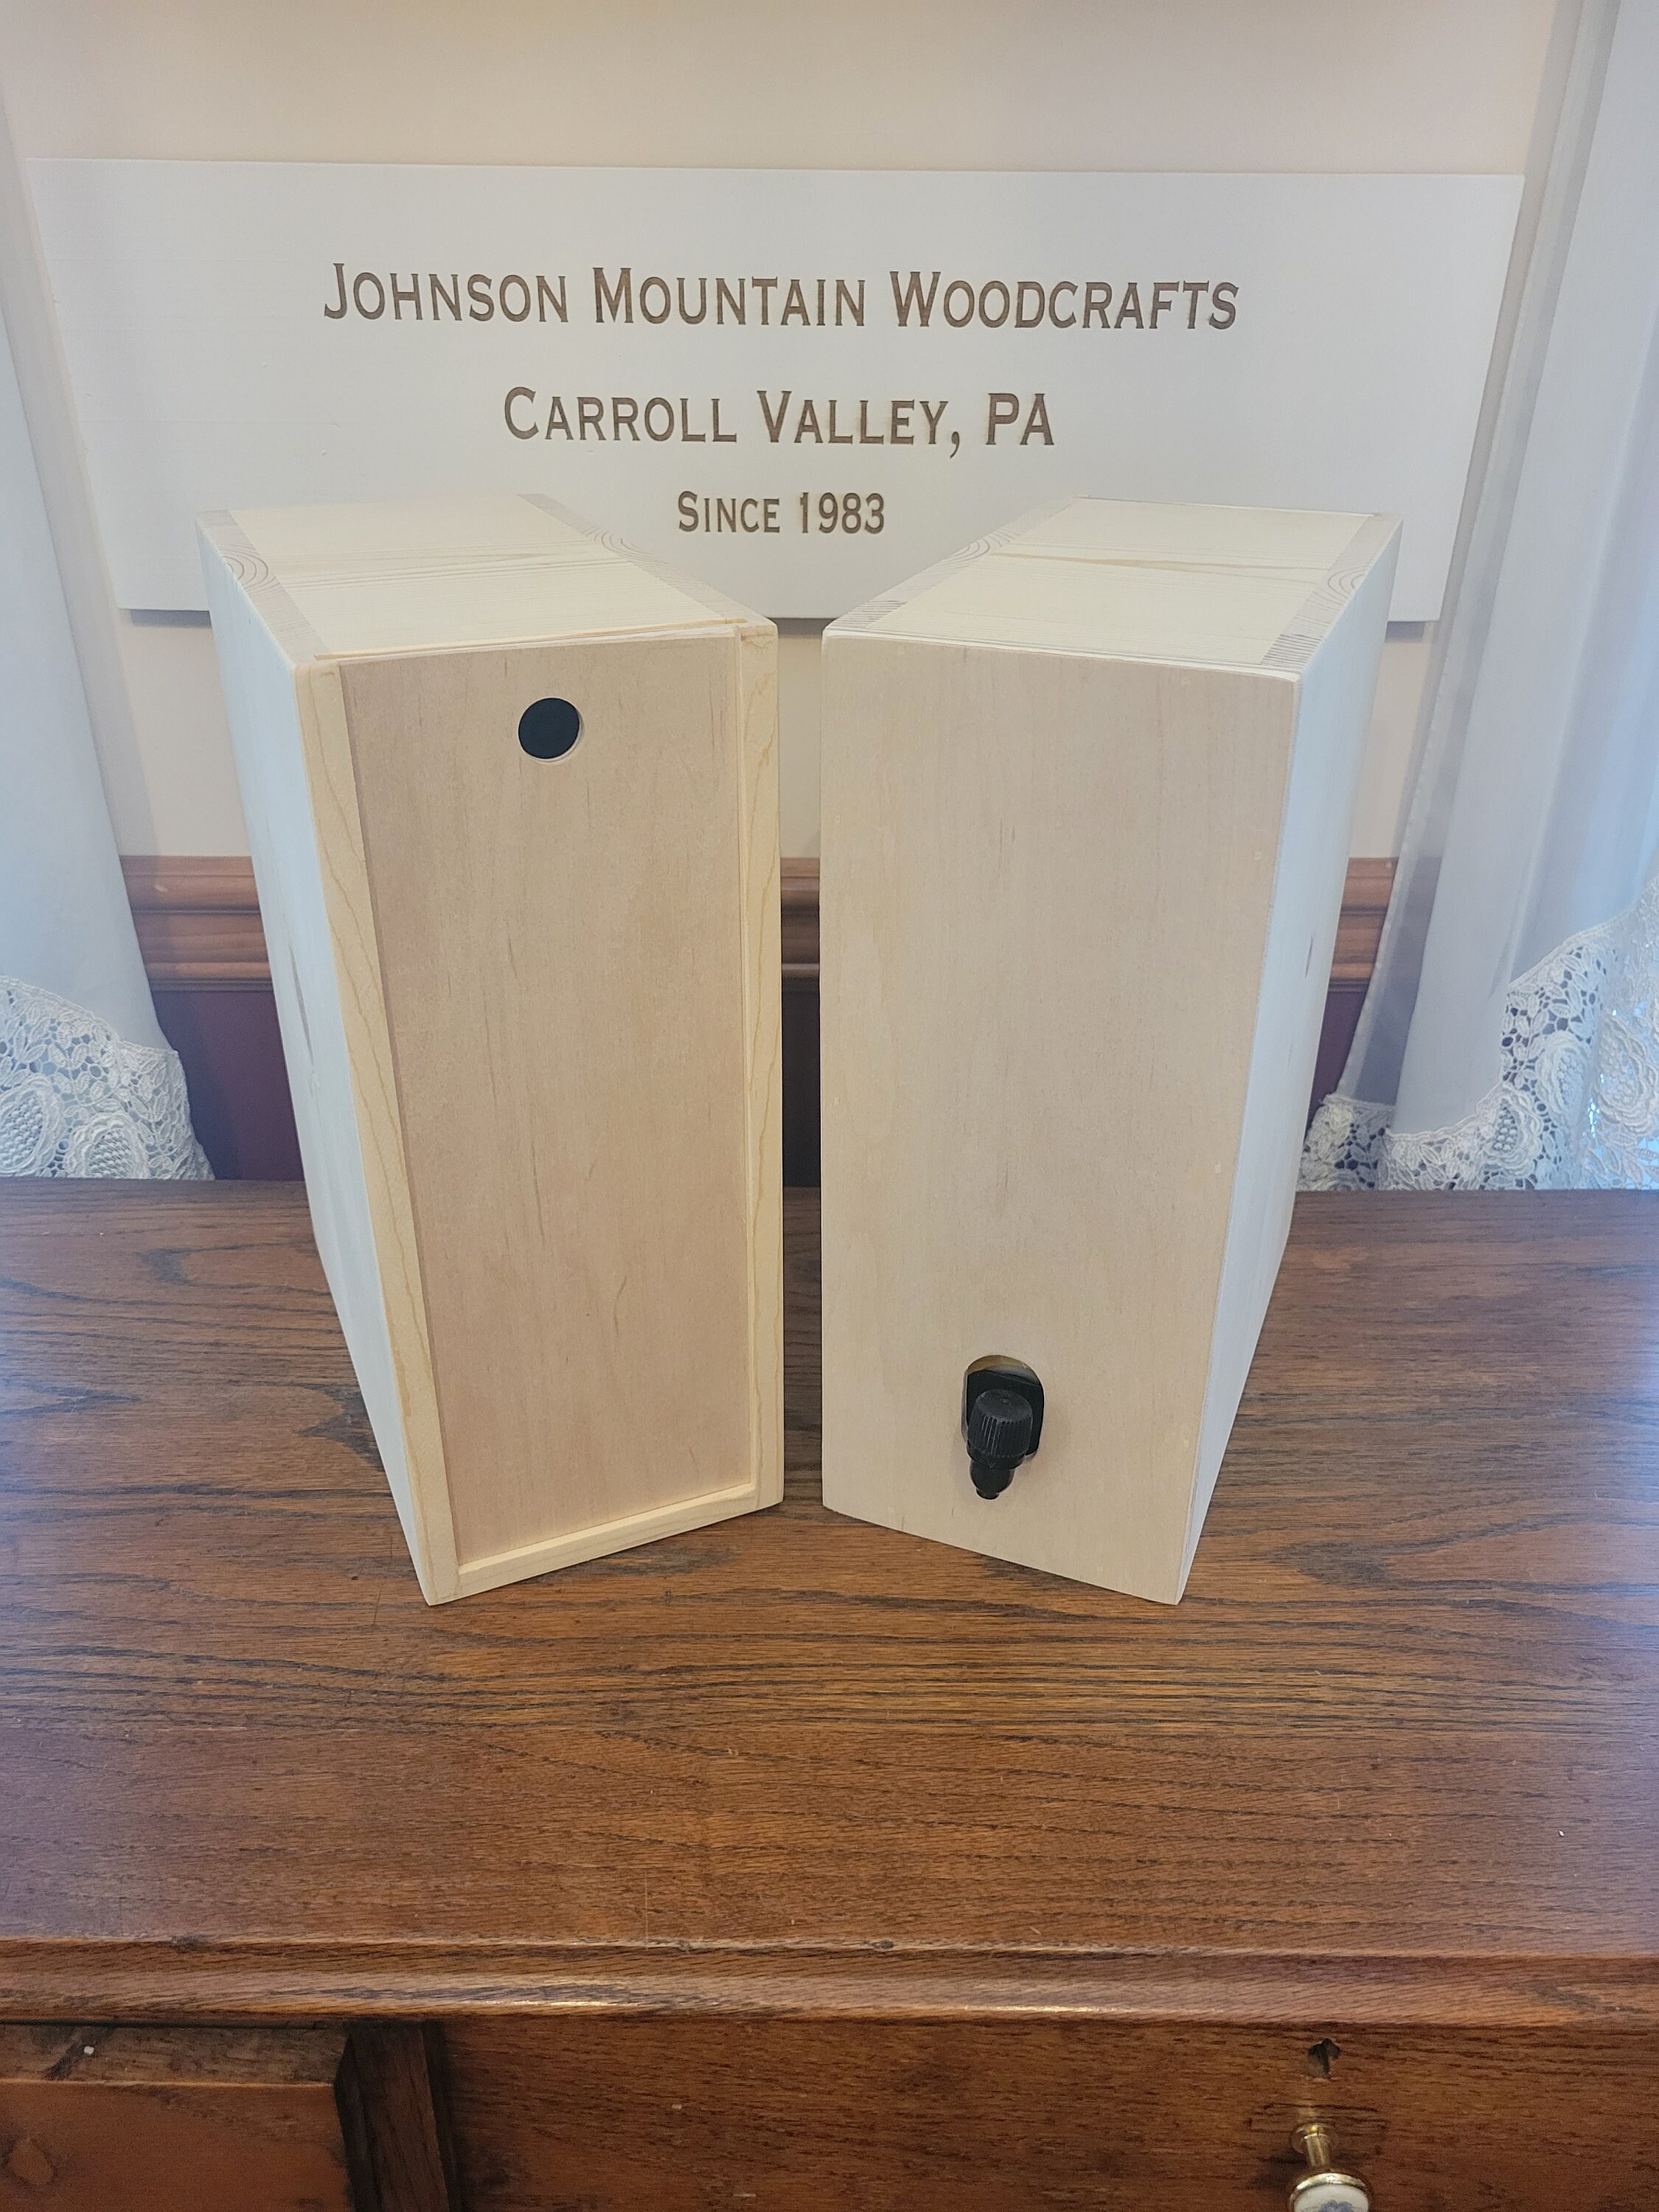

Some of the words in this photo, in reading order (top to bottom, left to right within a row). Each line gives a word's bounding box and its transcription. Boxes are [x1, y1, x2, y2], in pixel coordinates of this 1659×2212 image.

[324, 262, 569, 323] JOHNSON
[591, 267, 866, 327] MOUNTAIN
[888, 271, 1239, 330] WOODCRAFTS
[504, 386, 737, 444] CARROLL
[756, 390, 961, 459] VALLEY,
[984, 392, 1055, 447] PA
[678, 490, 781, 534] SINCE
[799, 492, 885, 535] 1983
